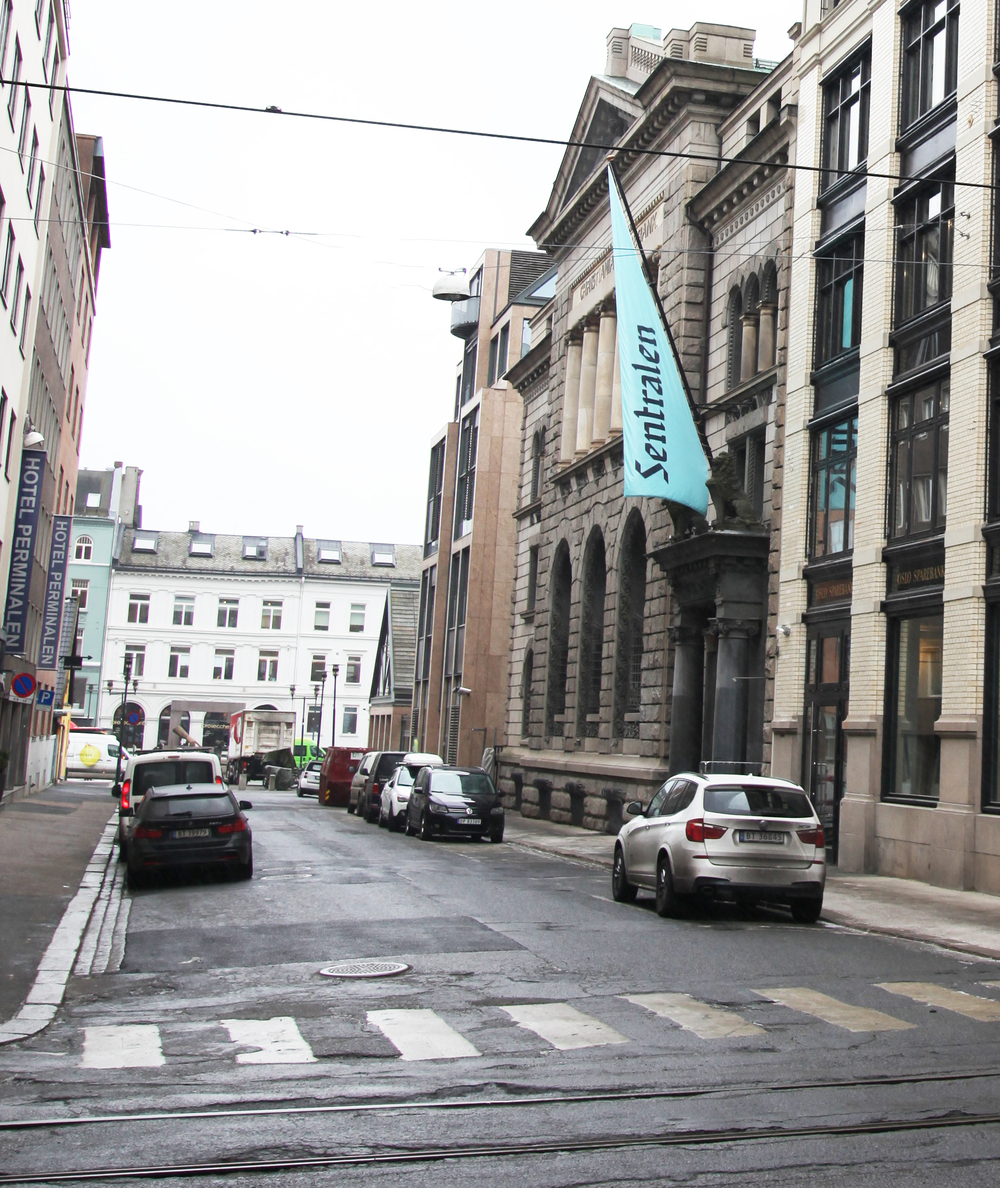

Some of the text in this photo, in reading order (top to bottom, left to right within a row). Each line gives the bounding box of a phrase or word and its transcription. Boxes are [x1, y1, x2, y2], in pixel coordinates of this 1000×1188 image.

[631, 324, 669, 484] Sentralen
[5, 457, 41, 648] HOTEL PERMINALEN
[41, 521, 68, 665] HOTEL PERMINALEN
[896, 572, 912, 586] OSLO
[41, 693, 50, 703] P
